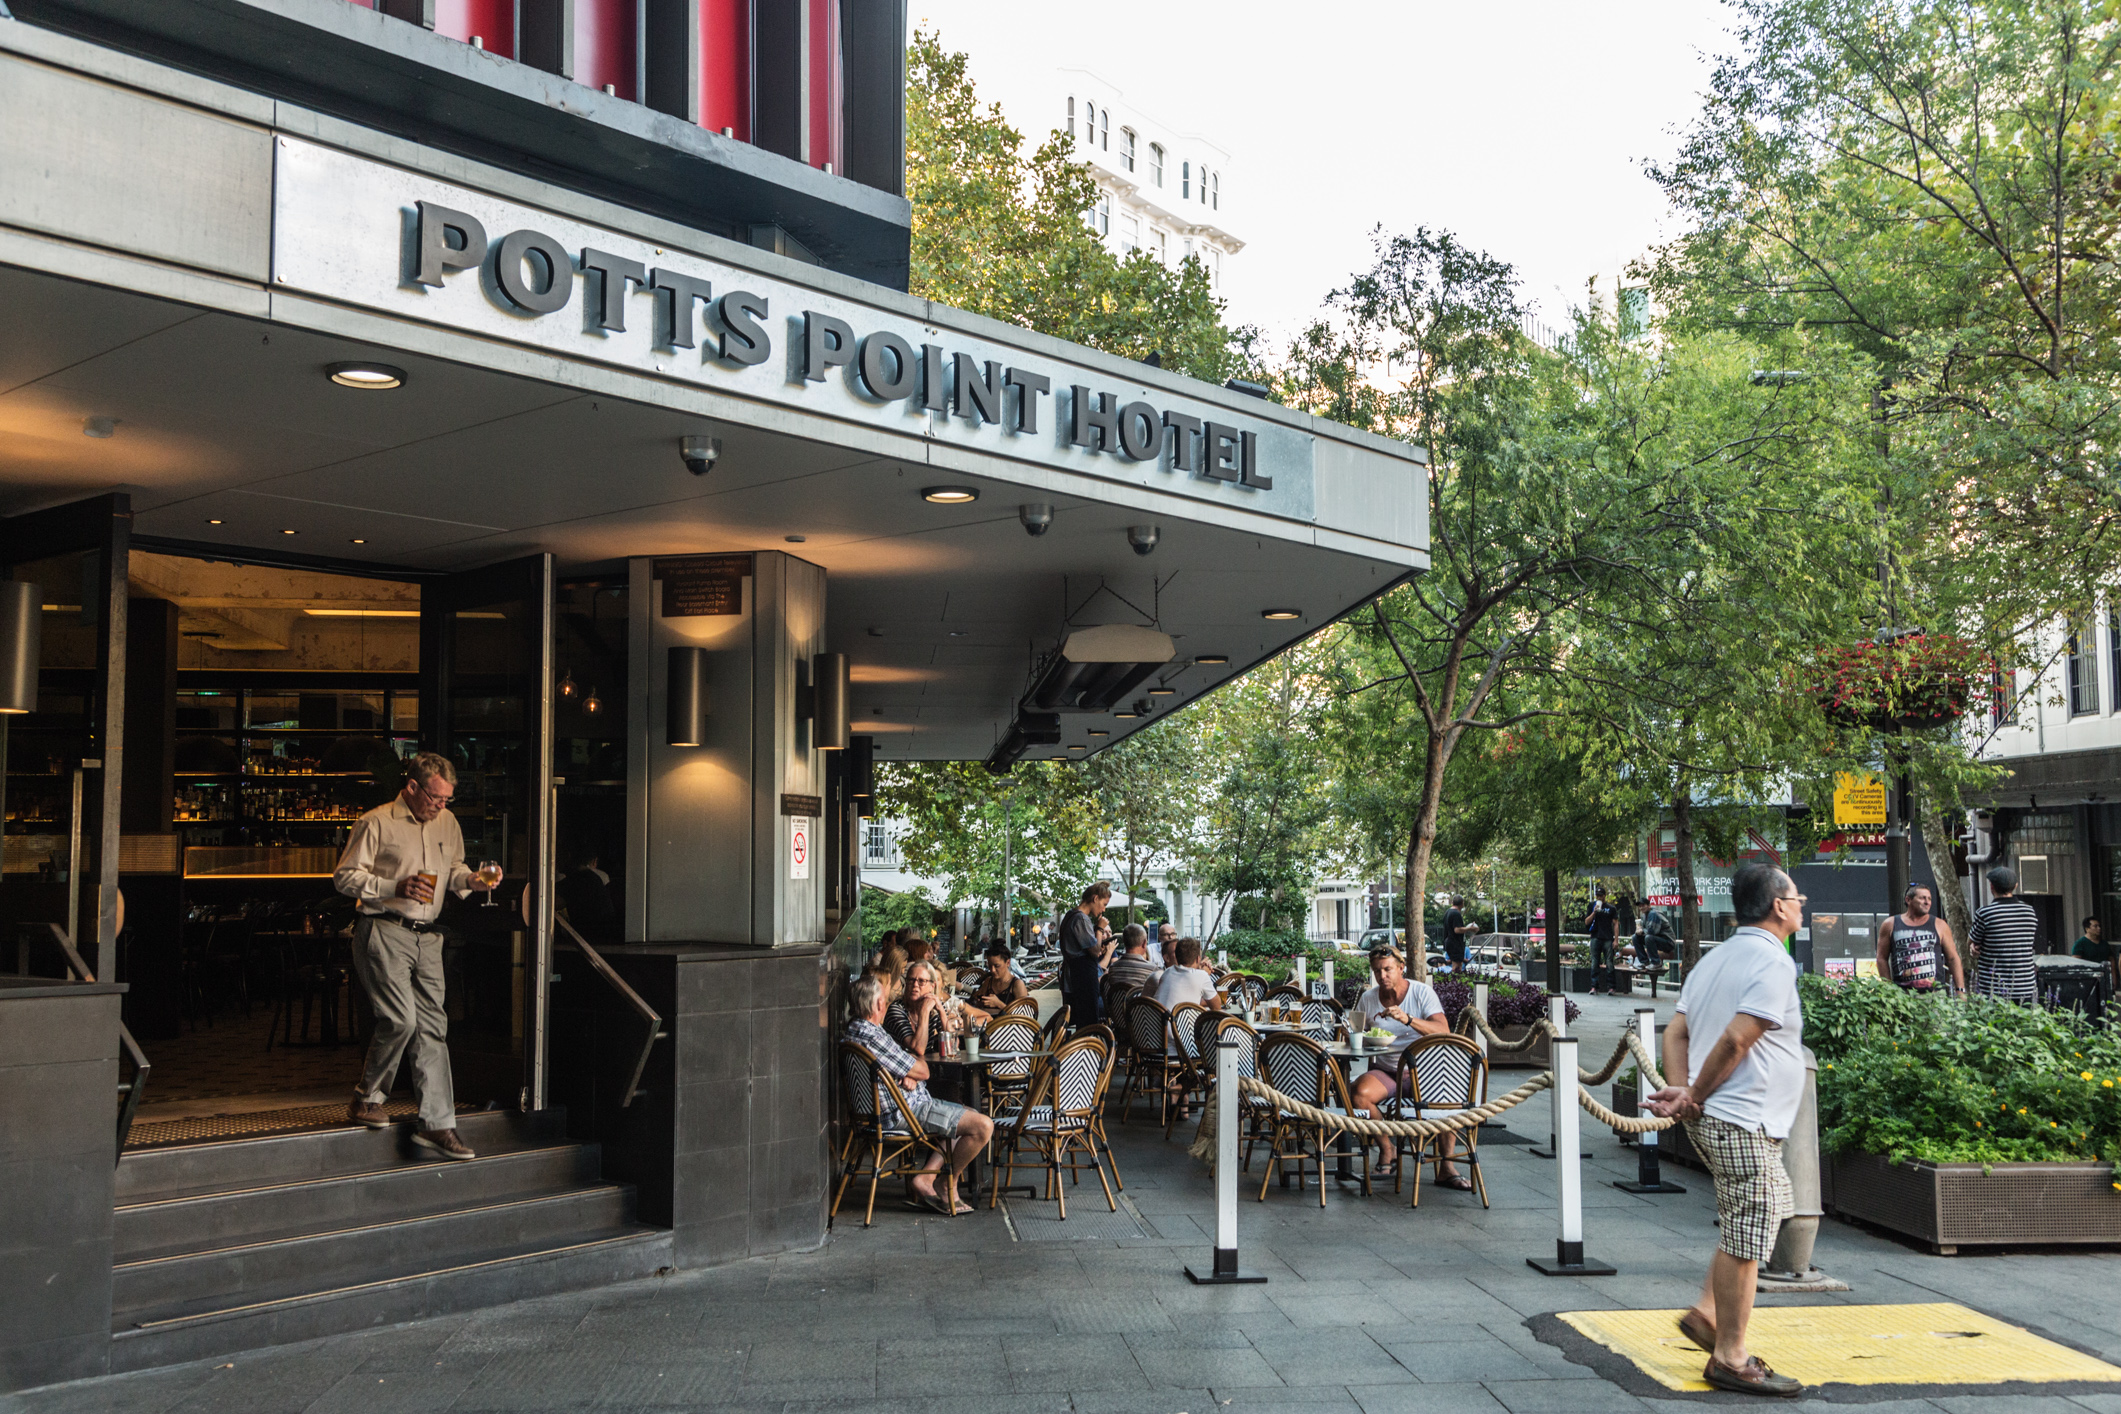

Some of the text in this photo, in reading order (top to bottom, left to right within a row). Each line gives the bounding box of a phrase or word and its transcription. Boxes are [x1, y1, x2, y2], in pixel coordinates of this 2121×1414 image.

[415, 199, 1273, 490] POTTS POINT HOTEL
[1648, 877, 1680, 886] SMART
[1693, 877, 1712, 886] ORK
[1648, 886, 1674, 895] WITH
[1707, 886, 1733, 895] ECOL
[1649, 896, 1680, 905] A NEW
[1314, 983, 1328, 996] 52
